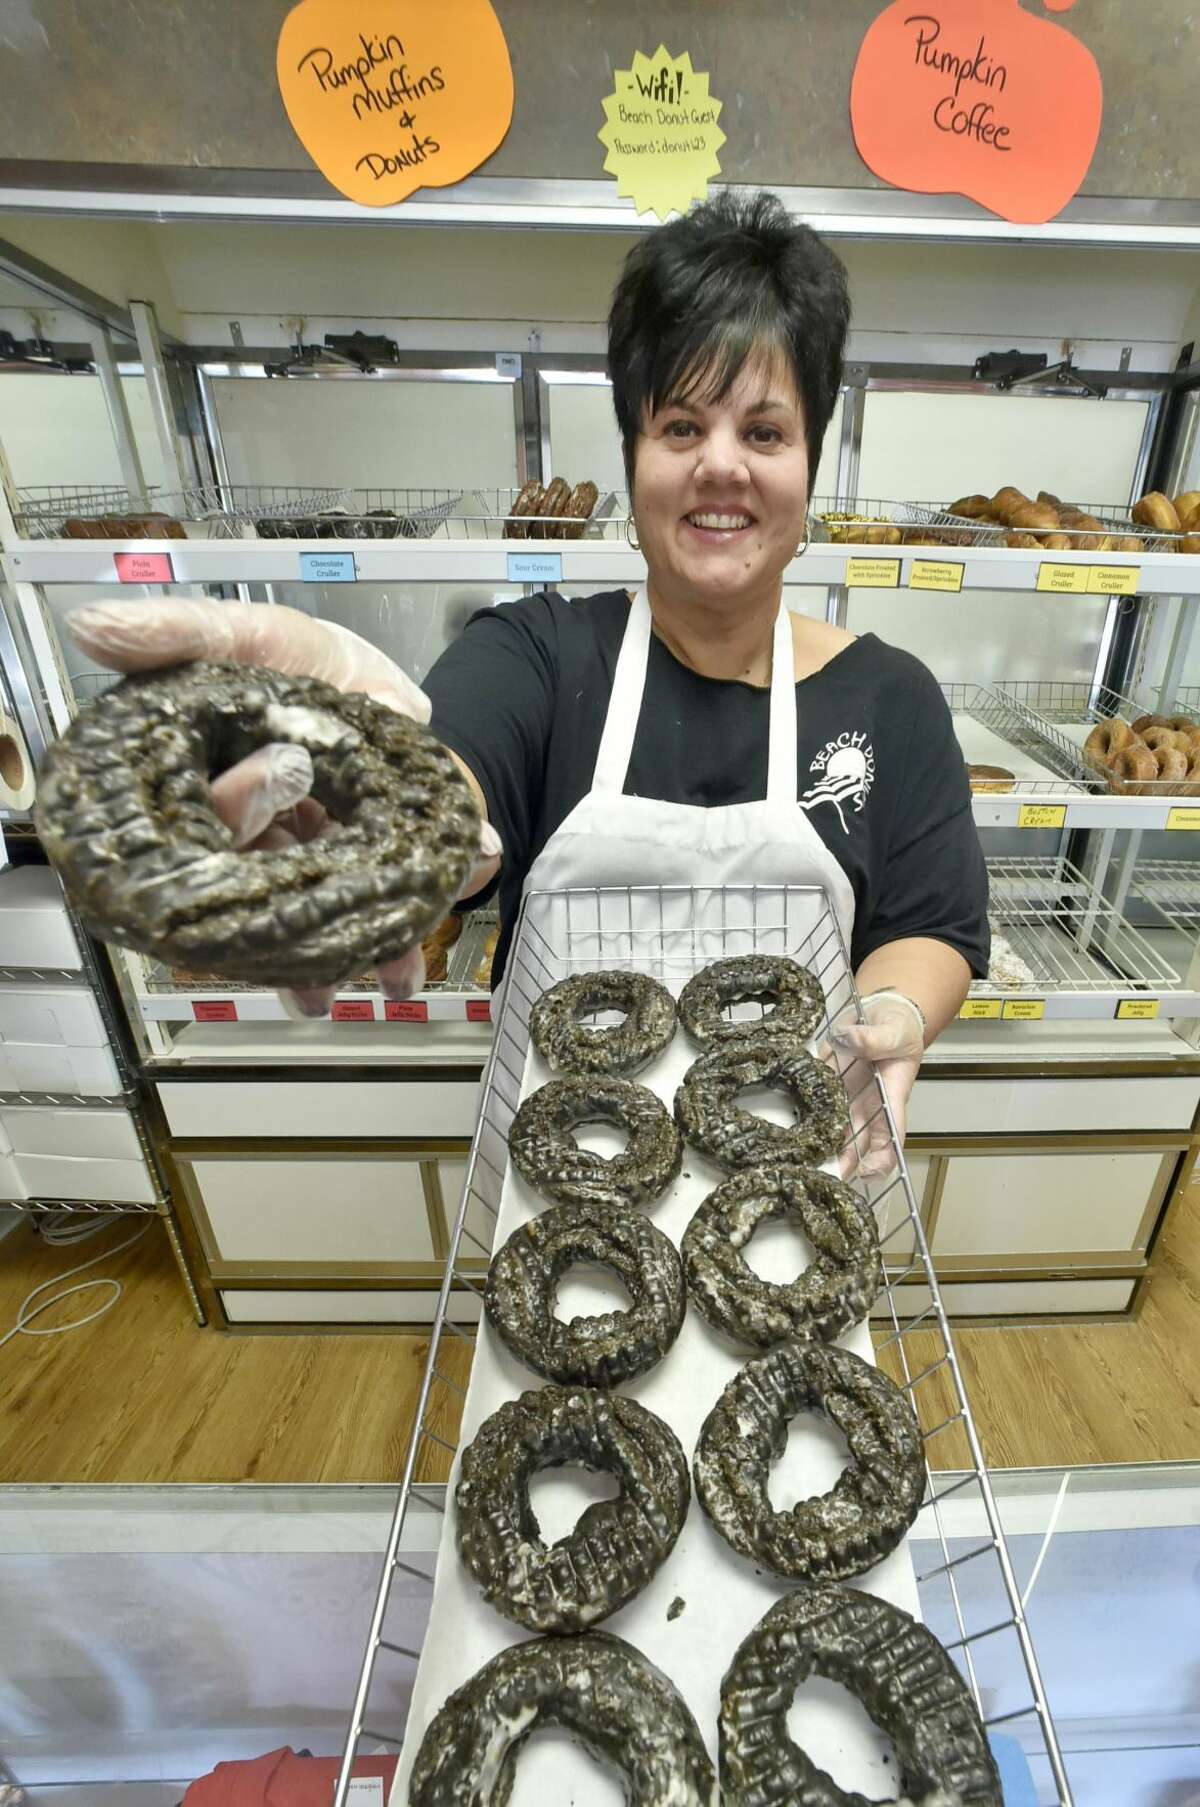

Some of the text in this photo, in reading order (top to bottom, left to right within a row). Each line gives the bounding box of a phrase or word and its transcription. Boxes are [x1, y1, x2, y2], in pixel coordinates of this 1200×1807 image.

[297, 33, 405, 93] Pumpkin
[904, 15, 1007, 97] Pumpkin
[618, 103, 715, 126] Beach Donut Guest
[933, 96, 1012, 151] Coffee
[1050, 580, 1073, 588] Cruller
[1053, 569, 1075, 578] Glazed
[1097, 571, 1130, 580] Cinnamon
[1101, 582, 1123, 590] Cruller
[809, 730, 867, 773] BEACH
